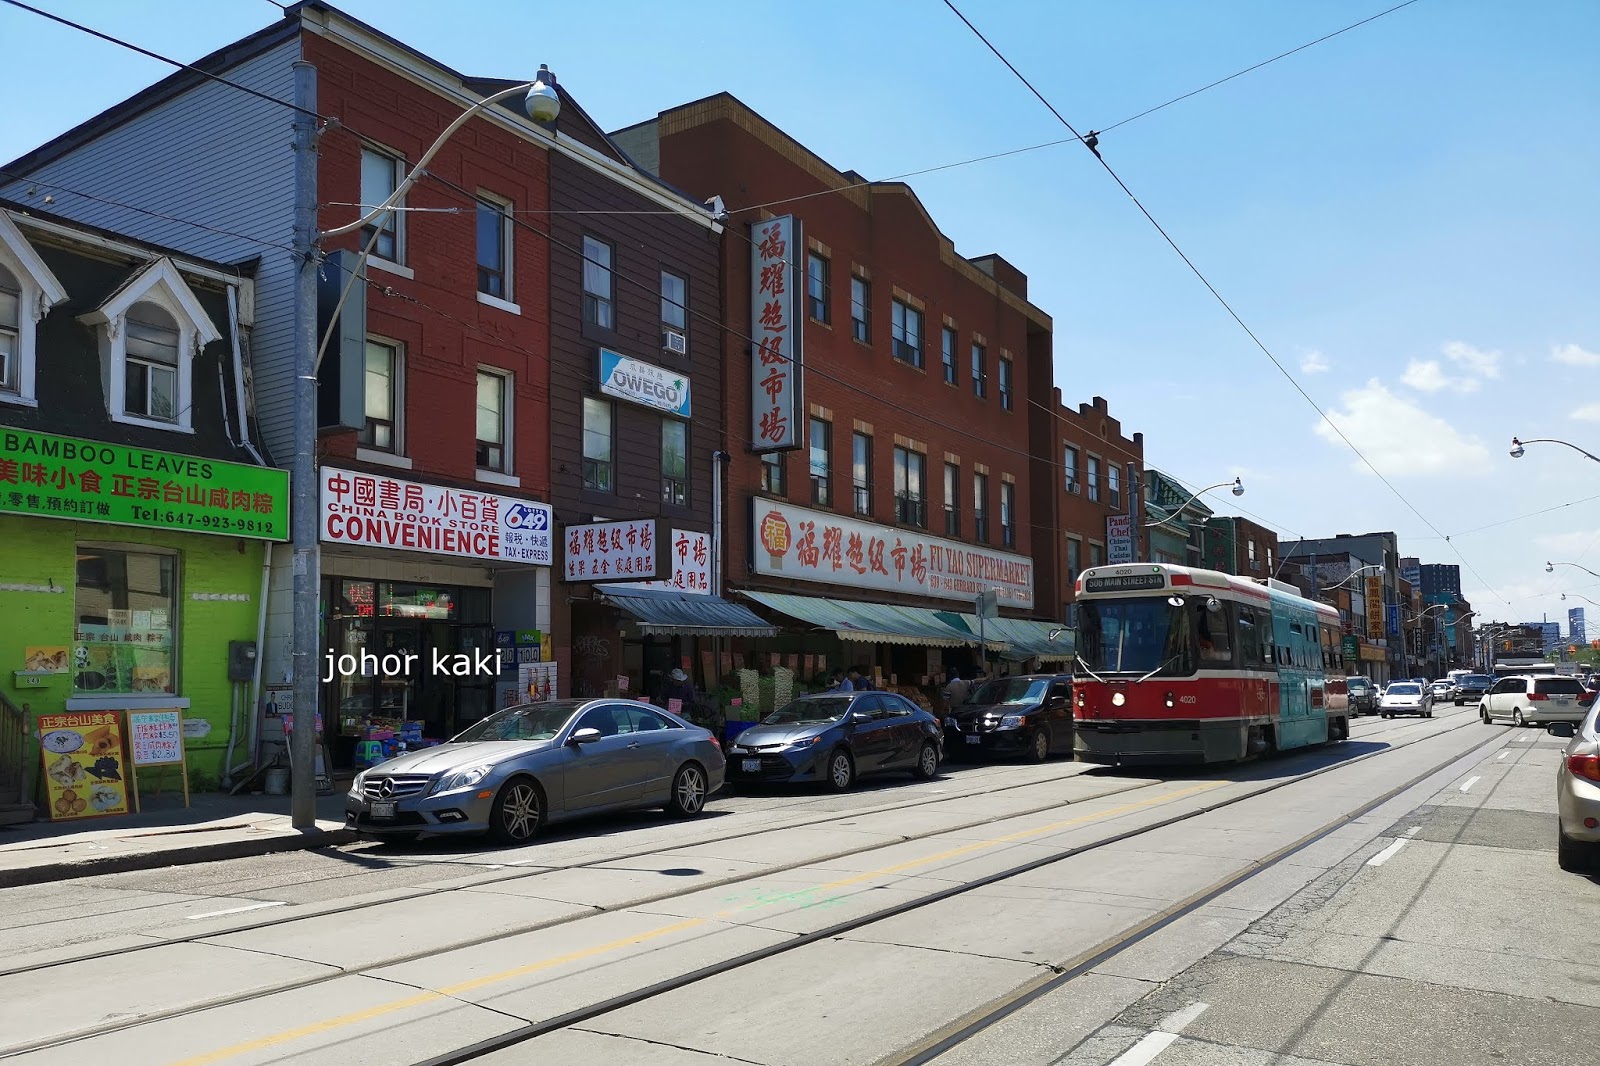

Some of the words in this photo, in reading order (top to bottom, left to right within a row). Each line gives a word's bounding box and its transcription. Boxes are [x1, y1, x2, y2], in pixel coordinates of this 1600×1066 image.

[613, 369, 678, 403] OWEGO
[5, 433, 116, 465] BAMBOO
[127, 451, 213, 480] LEAVES
[0, 458, 103, 494] 美味小食
[110, 473, 274, 514] 正宗台山咸肉粽
[327, 502, 387, 519] CHINA
[394, 512, 442, 526] BOOK
[449, 519, 500, 534] STORE
[505, 505, 546, 530] 649
[523, 507, 544, 515] LOTTO
[327, 514, 500, 557] CONVENIENCE
[675, 532, 707, 567] 市場
[765, 519, 786, 551] 福
[930, 544, 943, 572] FU
[946, 547, 964, 576] YAO
[966, 552, 1031, 587] SUPERMARKET
[1089, 577, 1103, 588] 506
[1104, 577, 1121, 586] MAIN
[1122, 575, 1147, 585] STREET
[1149, 575, 1162, 584] STN
[521, 634, 535, 642] MAX
[1179, 696, 1196, 704] 4020
[41, 713, 116, 728] 正宗台山美食
